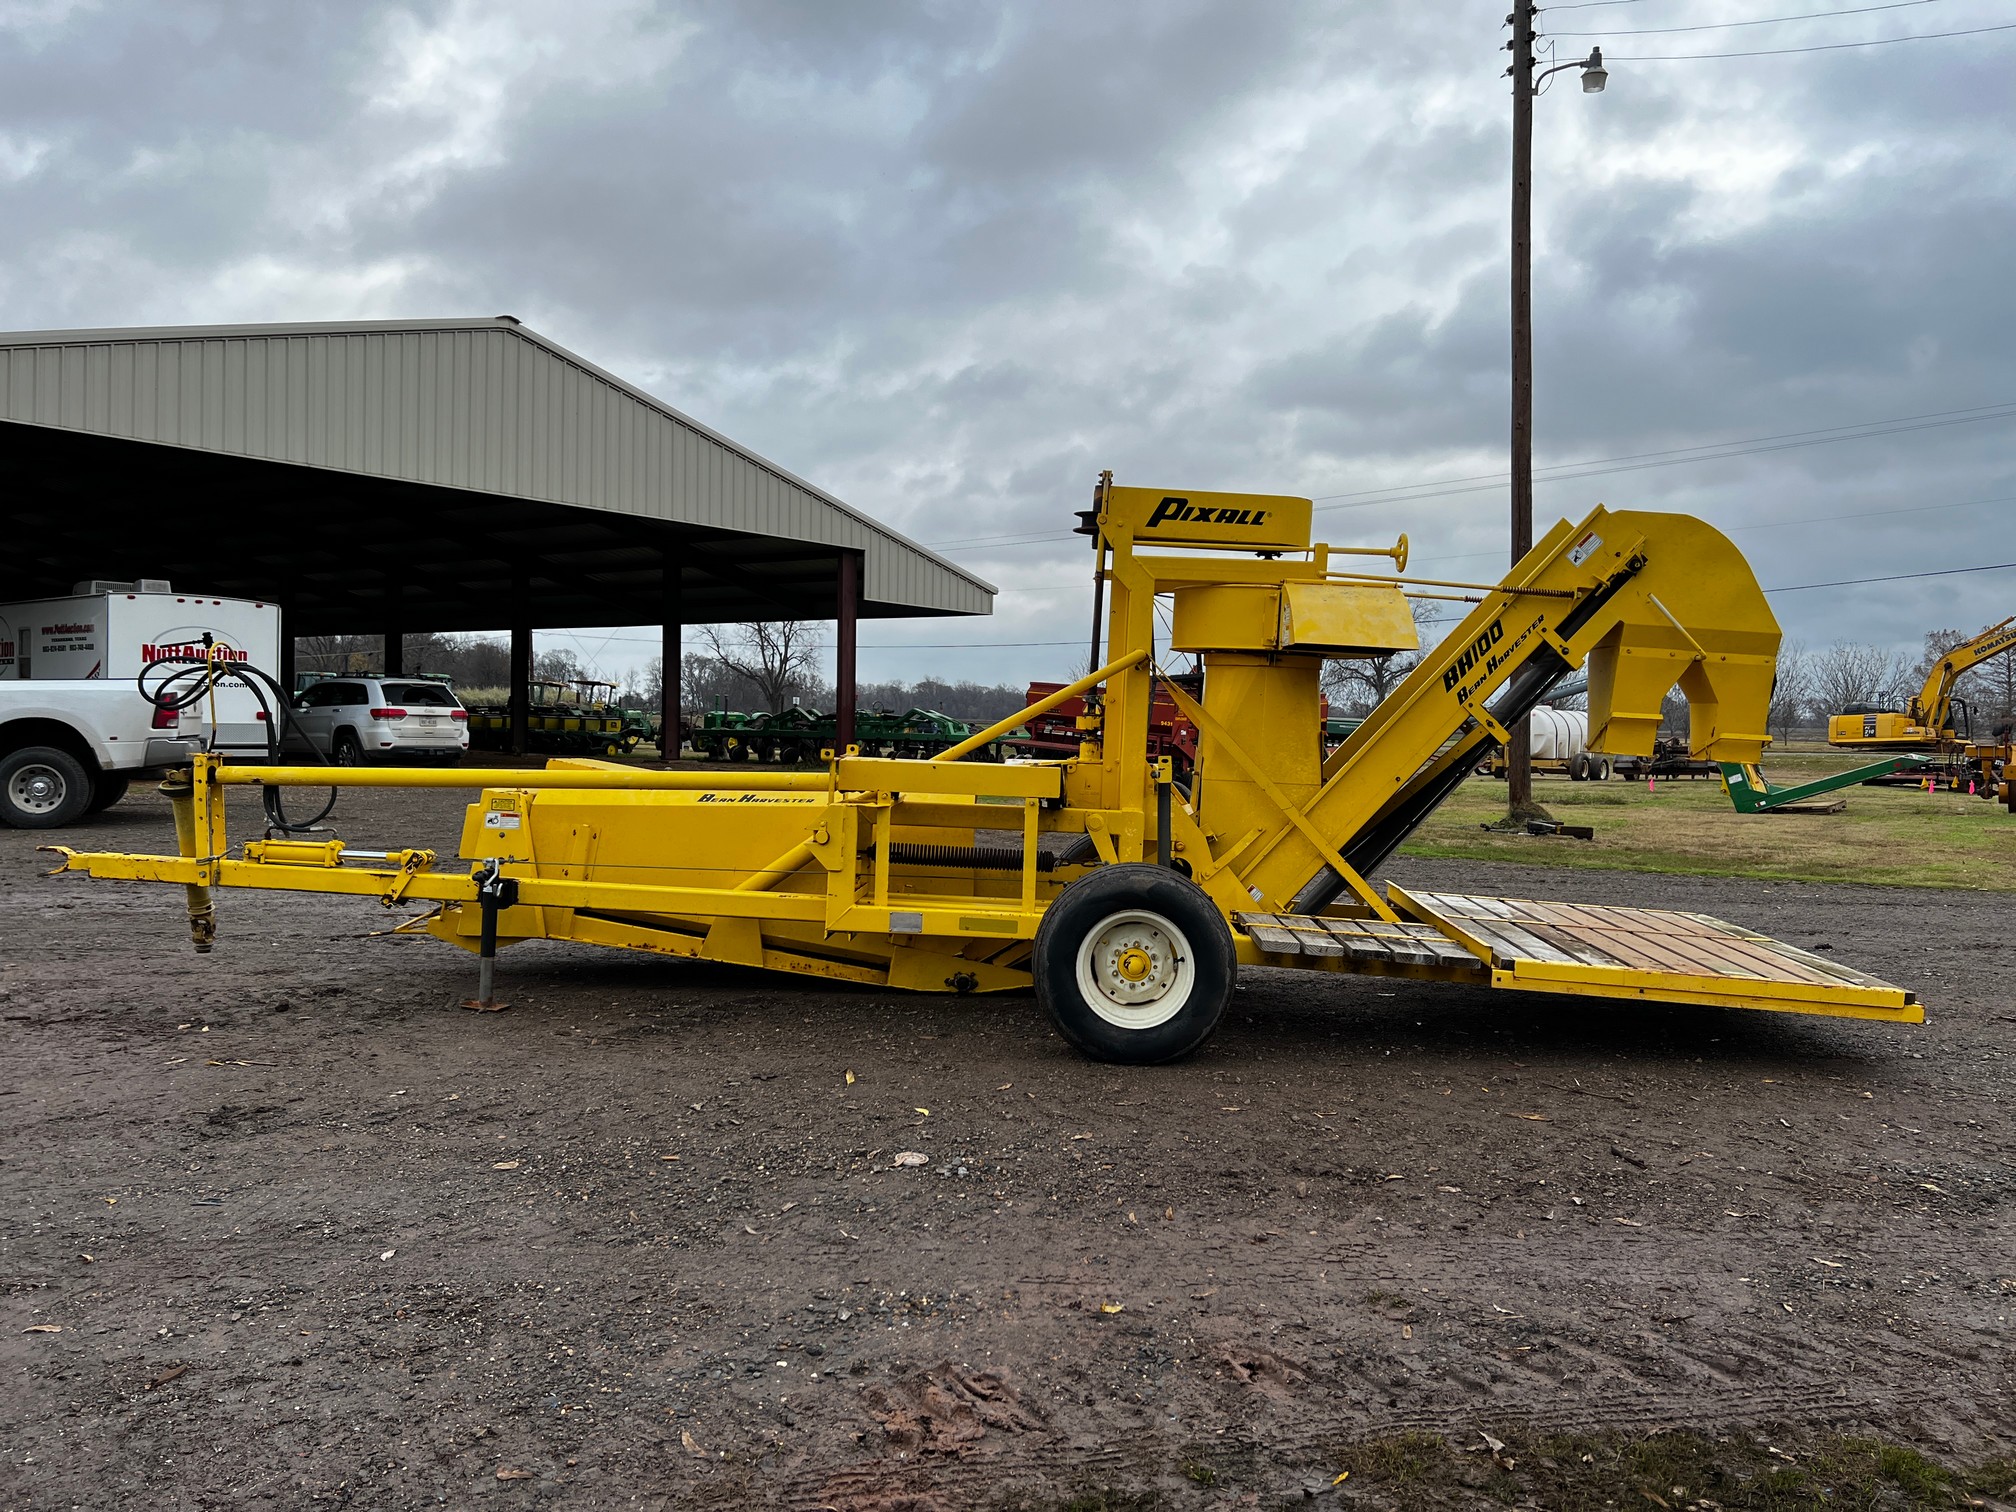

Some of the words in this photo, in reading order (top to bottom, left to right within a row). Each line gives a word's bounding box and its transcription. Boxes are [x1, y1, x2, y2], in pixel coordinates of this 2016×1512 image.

[1145, 497, 1266, 527] PIXALL
[142, 644, 247, 663] NuttAuction
[1443, 619, 1504, 693] BH100
[1457, 673, 1487, 706] BEAN
[1486, 614, 1545, 675] HARVESTER
[697, 794, 736, 802] BEAN
[738, 794, 815, 803] HARVESTER
